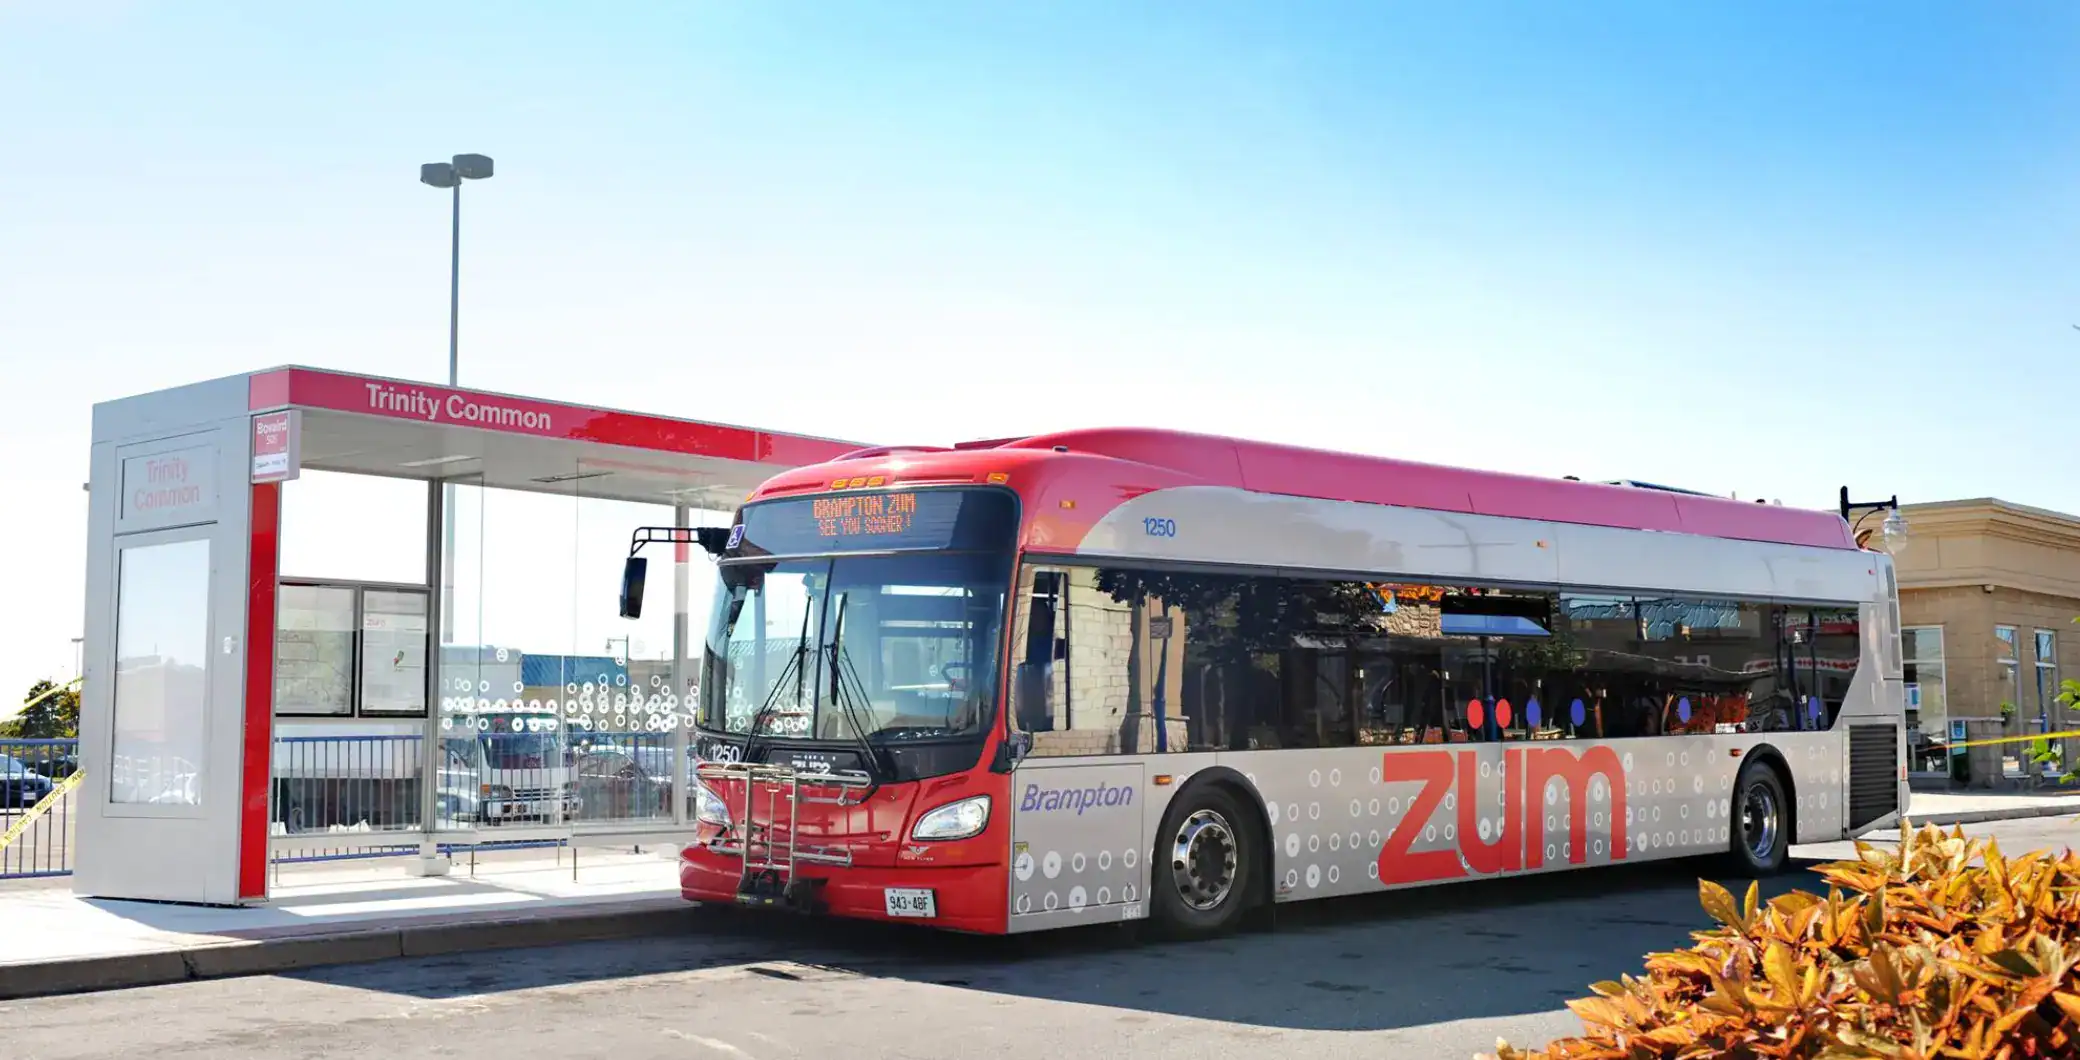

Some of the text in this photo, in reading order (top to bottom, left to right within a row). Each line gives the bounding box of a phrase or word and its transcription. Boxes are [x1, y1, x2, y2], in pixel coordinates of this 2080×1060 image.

[365, 383, 551, 430] Trinity Common
[146, 457, 188, 483] Trinity
[134, 485, 200, 511] Common
[813, 496, 883, 519] BRAMPTON
[819, 519, 838, 536] SEE
[840, 517, 860, 535] YOU
[1141, 517, 1176, 537] 1250
[711, 744, 740, 763] 1250
[1020, 781, 1133, 815] Brampton
